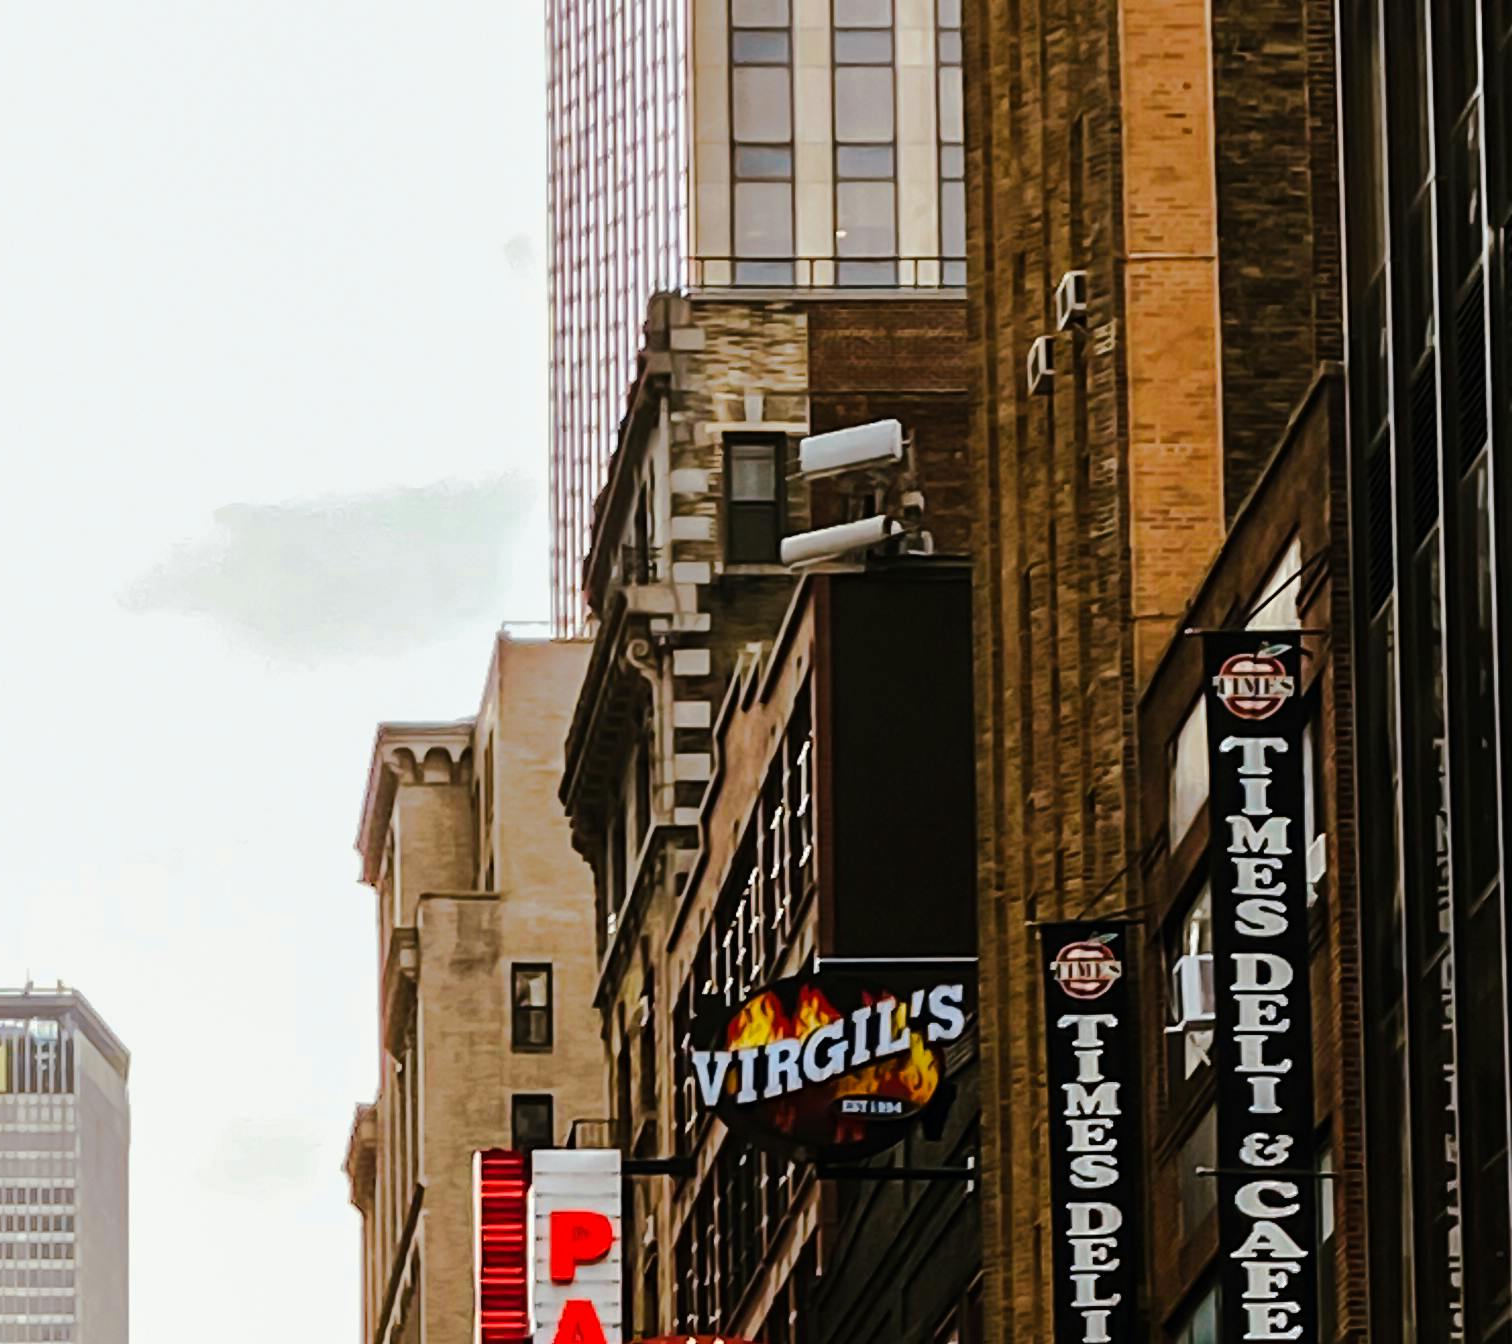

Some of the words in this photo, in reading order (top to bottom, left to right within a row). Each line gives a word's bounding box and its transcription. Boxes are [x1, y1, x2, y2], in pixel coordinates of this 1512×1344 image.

[1218, 736, 1293, 938] TIMES
[692, 984, 965, 1106] VIRGIL'S
[1055, 1014, 1122, 1190] TIMES
[1229, 953, 1294, 1114] DELI
[1239, 1132, 1294, 1168] &
[1064, 1202, 1124, 1344] DELI
[1229, 1180, 1309, 1341] CAFE
